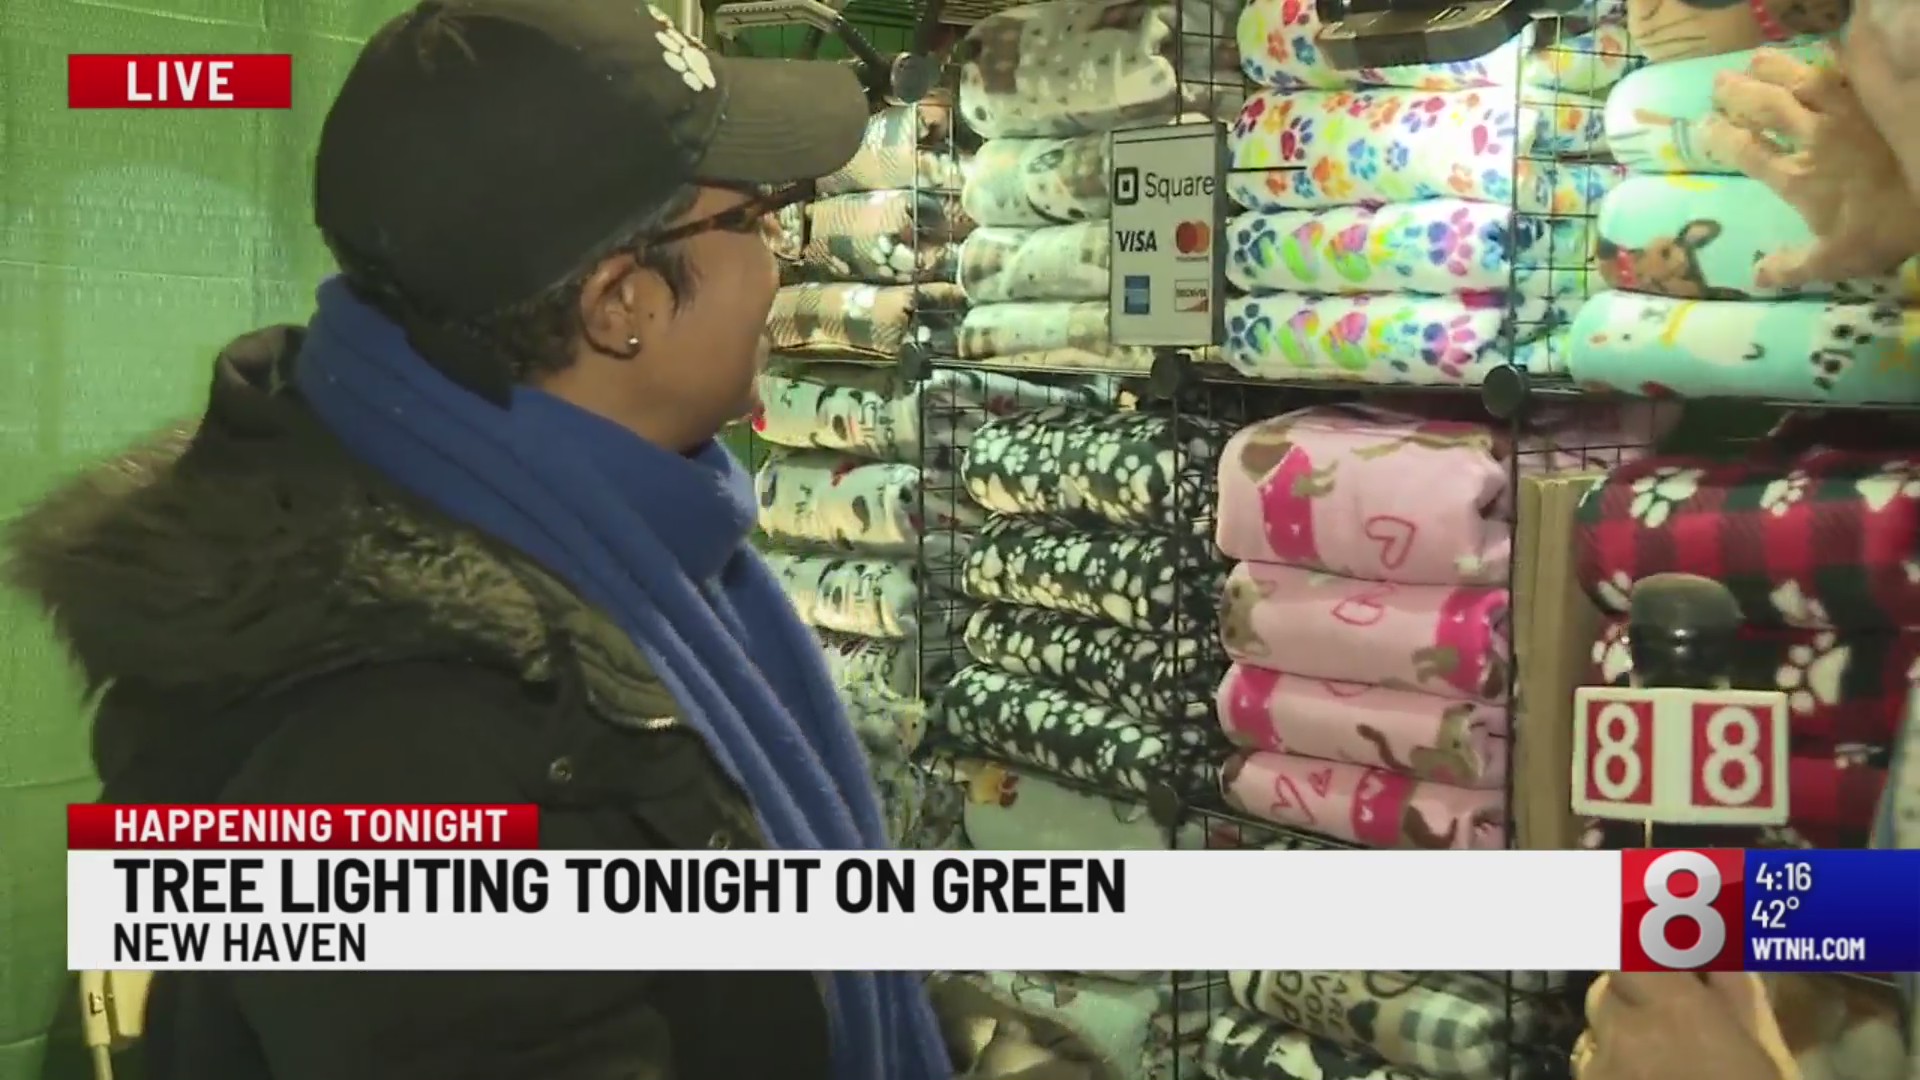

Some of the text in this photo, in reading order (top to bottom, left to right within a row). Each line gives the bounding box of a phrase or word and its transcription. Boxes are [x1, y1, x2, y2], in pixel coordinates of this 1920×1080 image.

[1145, 172, 1215, 203] Square
[1116, 230, 1157, 252] VISA
[1593, 703, 1641, 800] 8
[1702, 705, 1763, 805] 8
